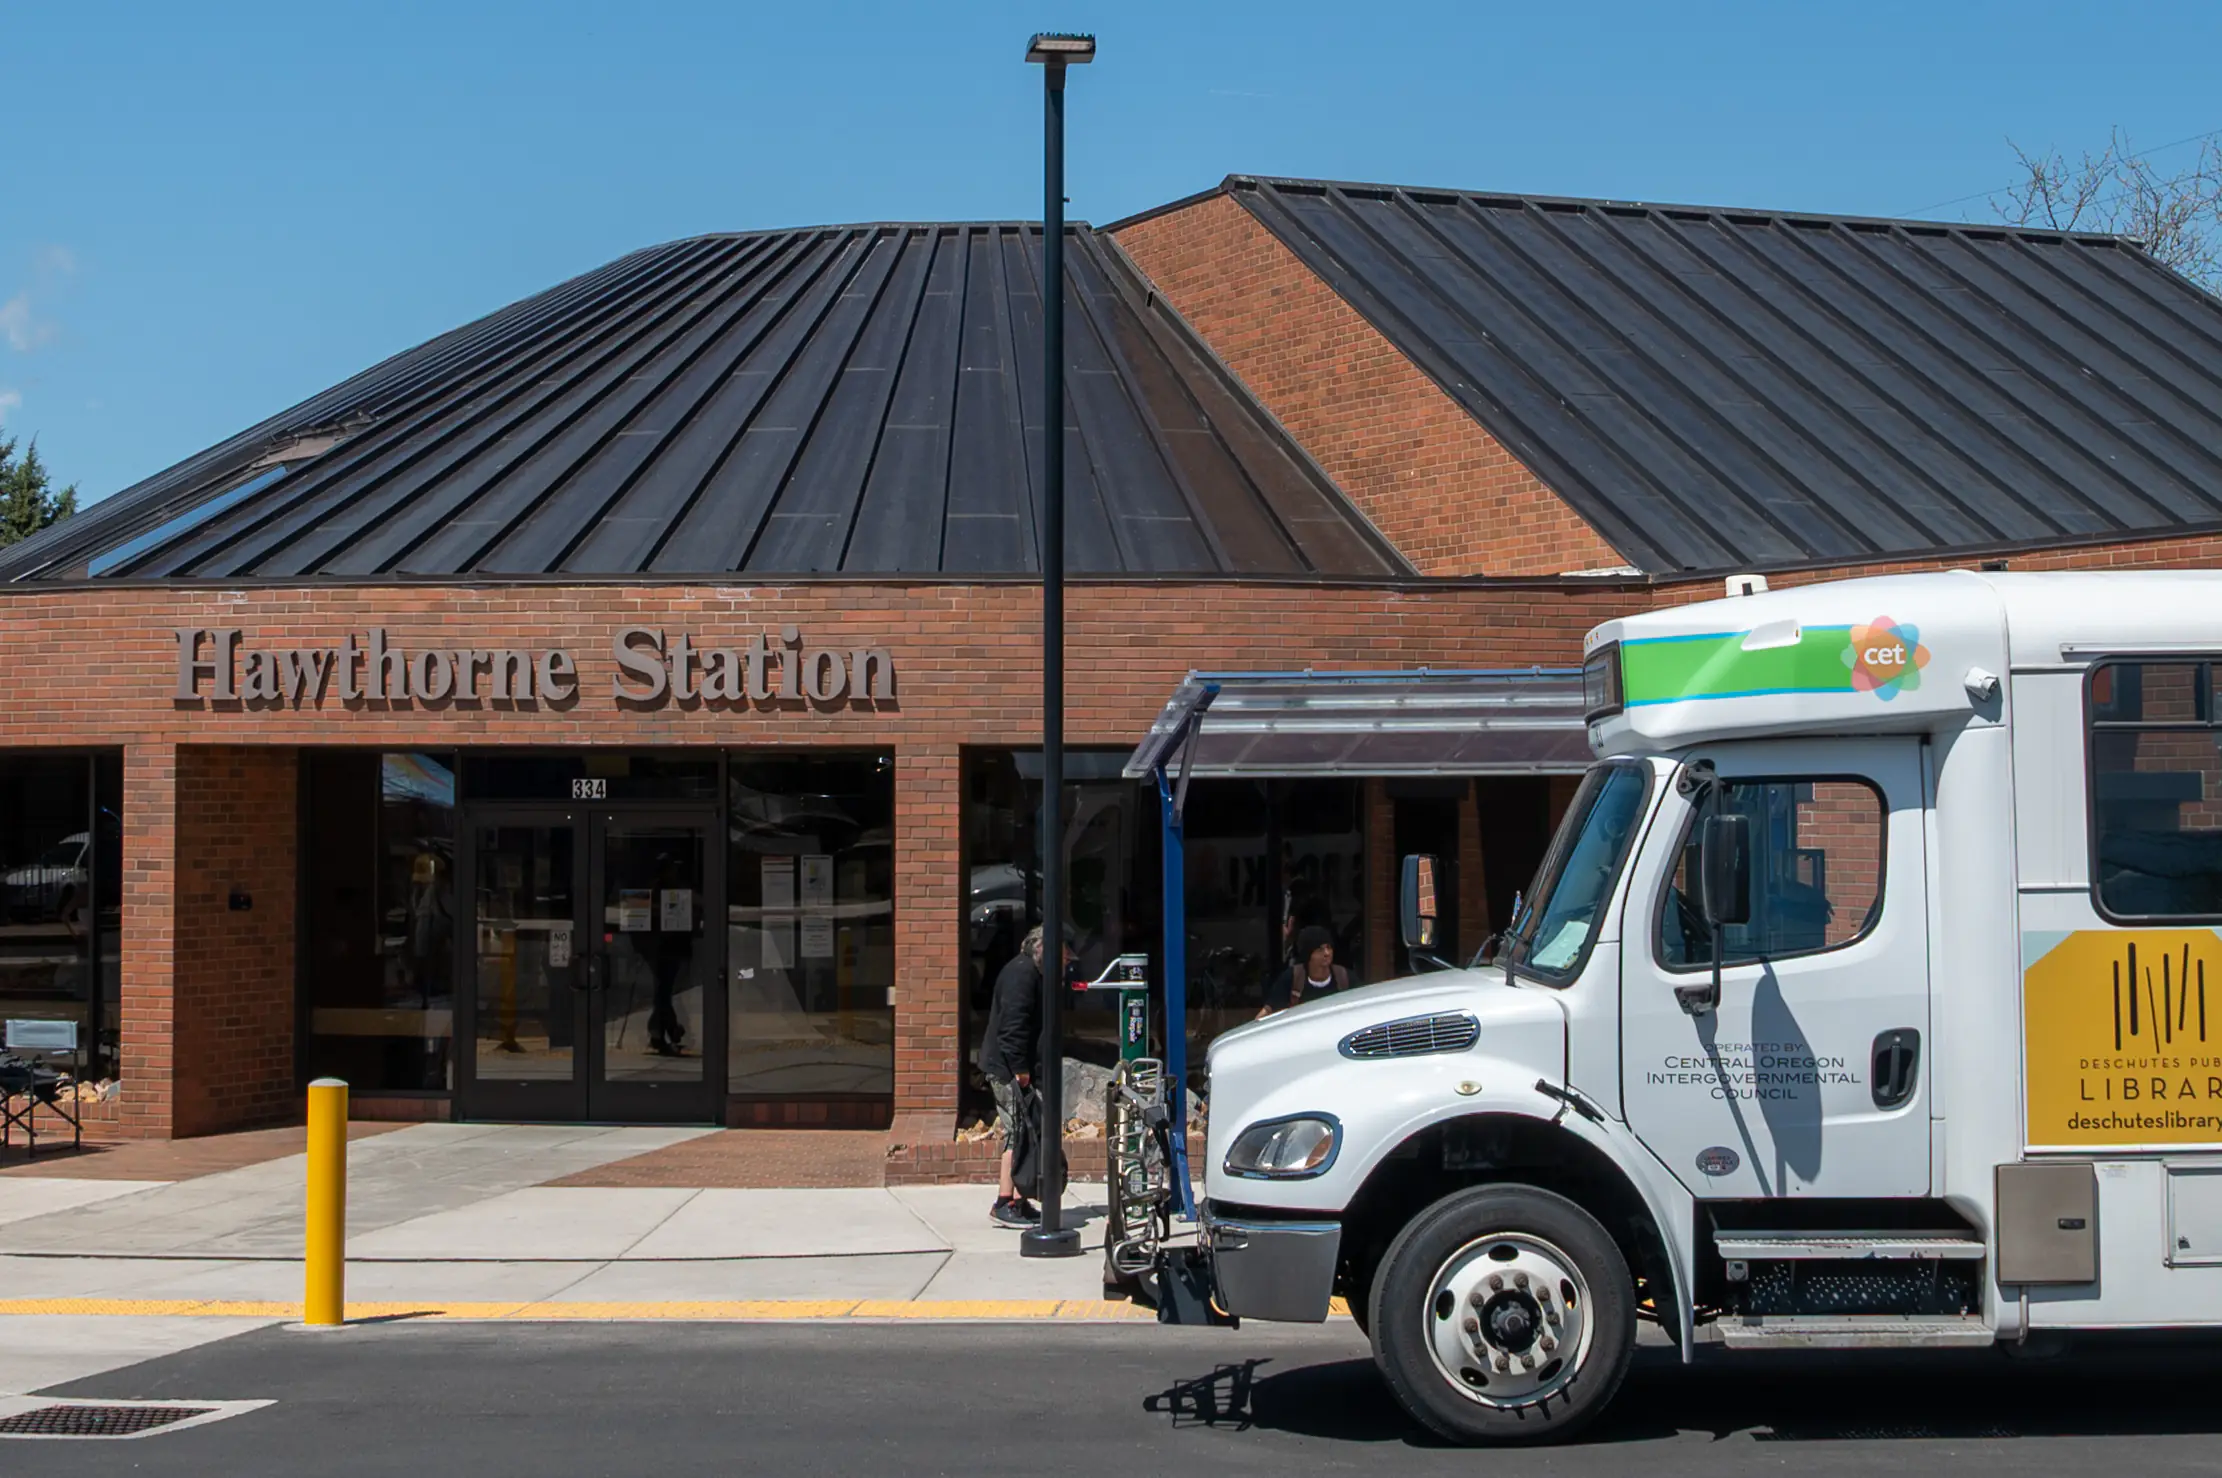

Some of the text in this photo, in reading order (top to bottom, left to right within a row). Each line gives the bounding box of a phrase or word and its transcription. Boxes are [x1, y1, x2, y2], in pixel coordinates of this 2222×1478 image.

[1863, 643, 1907, 665] cet
[175, 625, 897, 704] Hawthorne Station
[574, 779, 605, 799] 334
[1704, 1042, 1804, 1053] OPERATED BY
[1664, 1055, 1845, 1069] CENTRAL OREGON
[2079, 1056, 2222, 1070] DESCHUTES PUB
[1646, 1072, 1862, 1085] INTERGOVERNMENTAL
[1710, 1086, 1798, 1100] COUNCIL
[2080, 1076, 2222, 1101] LIBRAR
[2067, 1109, 2222, 1132] deschuteslibrary
